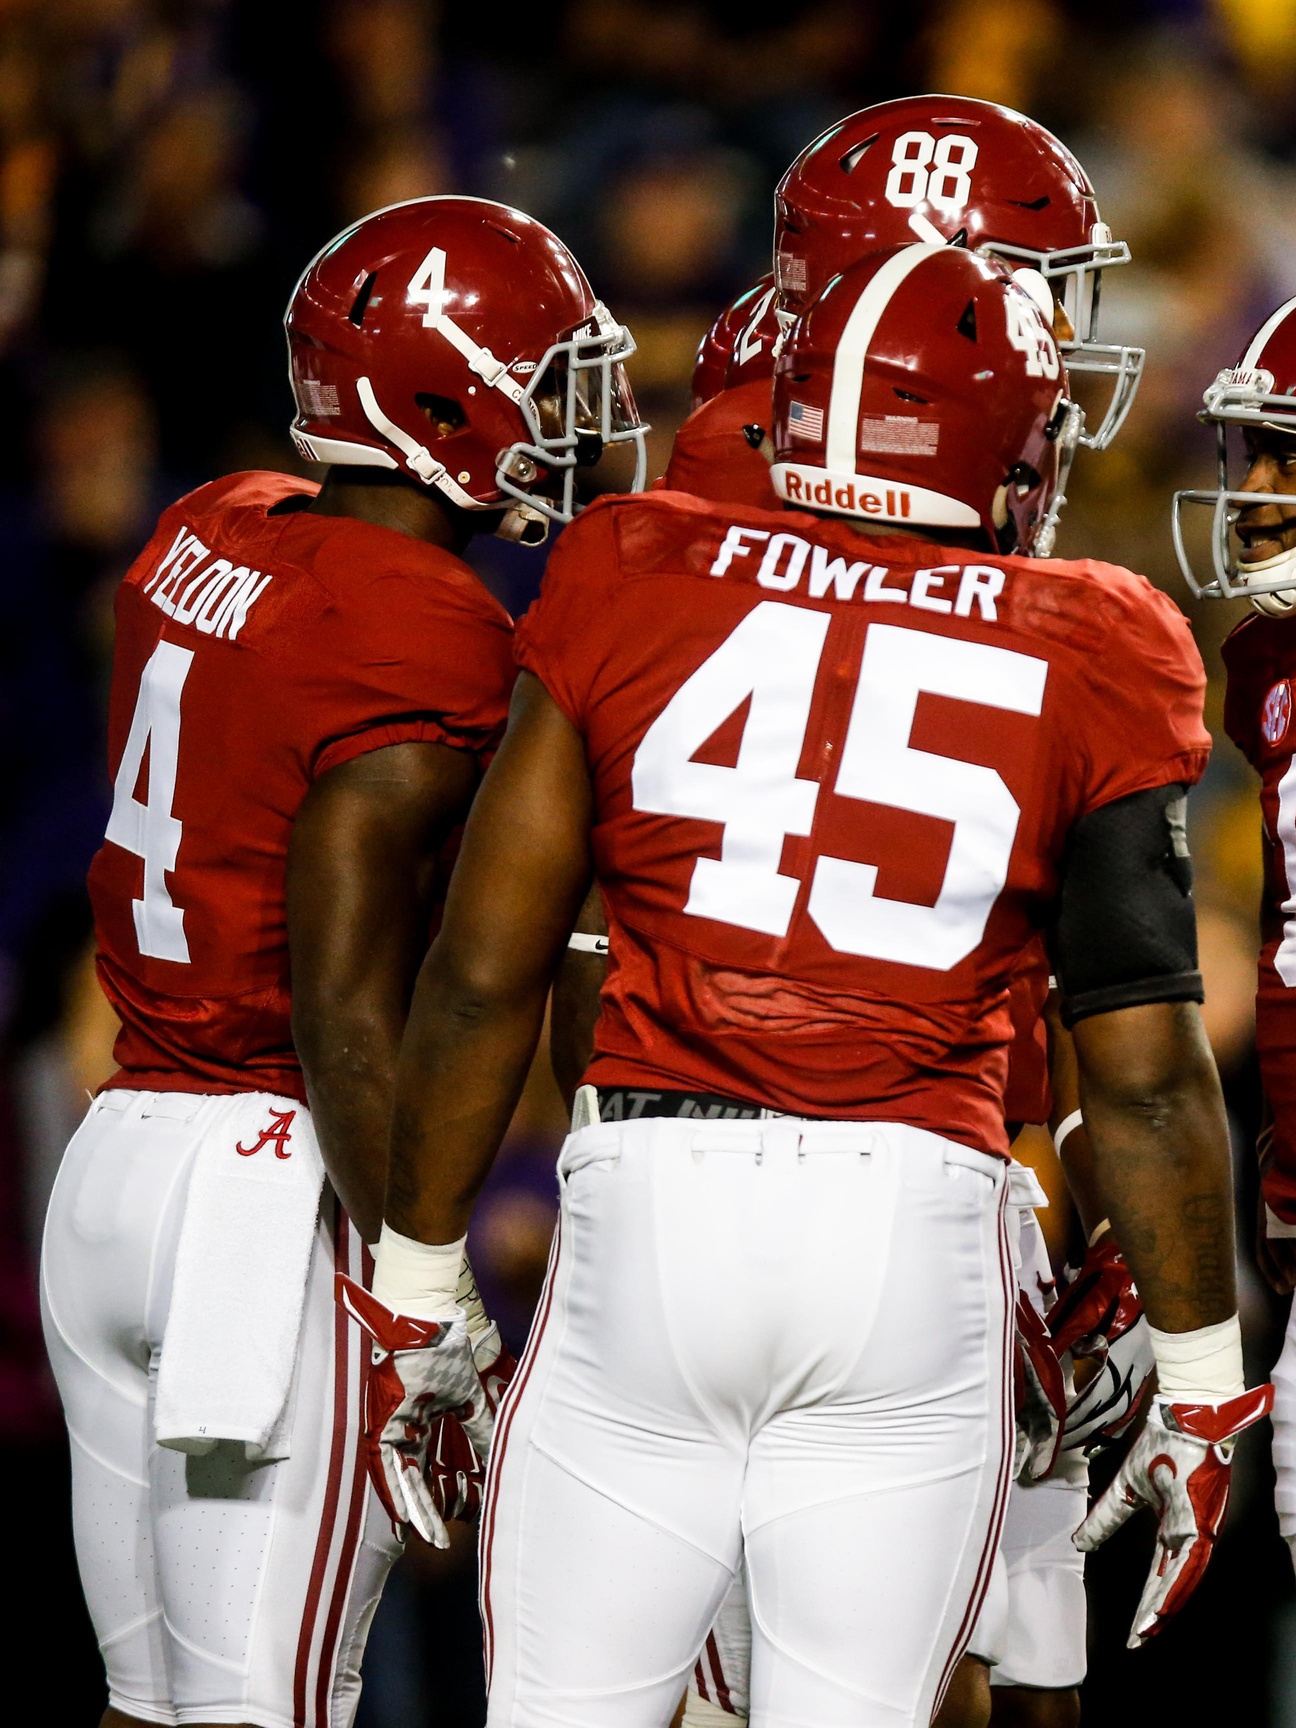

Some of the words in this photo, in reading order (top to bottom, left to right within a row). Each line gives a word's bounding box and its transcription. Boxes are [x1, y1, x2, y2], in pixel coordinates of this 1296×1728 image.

[884, 131, 979, 209] 88
[406, 246, 451, 328] 4
[514, 364, 538, 372] SPEED
[1003, 284, 1060, 380] 45
[785, 470, 912, 518] Riddell
[143, 525, 274, 641] YELDON
[709, 525, 1006, 622] FOWLER
[104, 639, 196, 964] 4
[631, 600, 1049, 972] 45
[236, 1107, 297, 1159] A
[600, 1092, 662, 1122] AT
